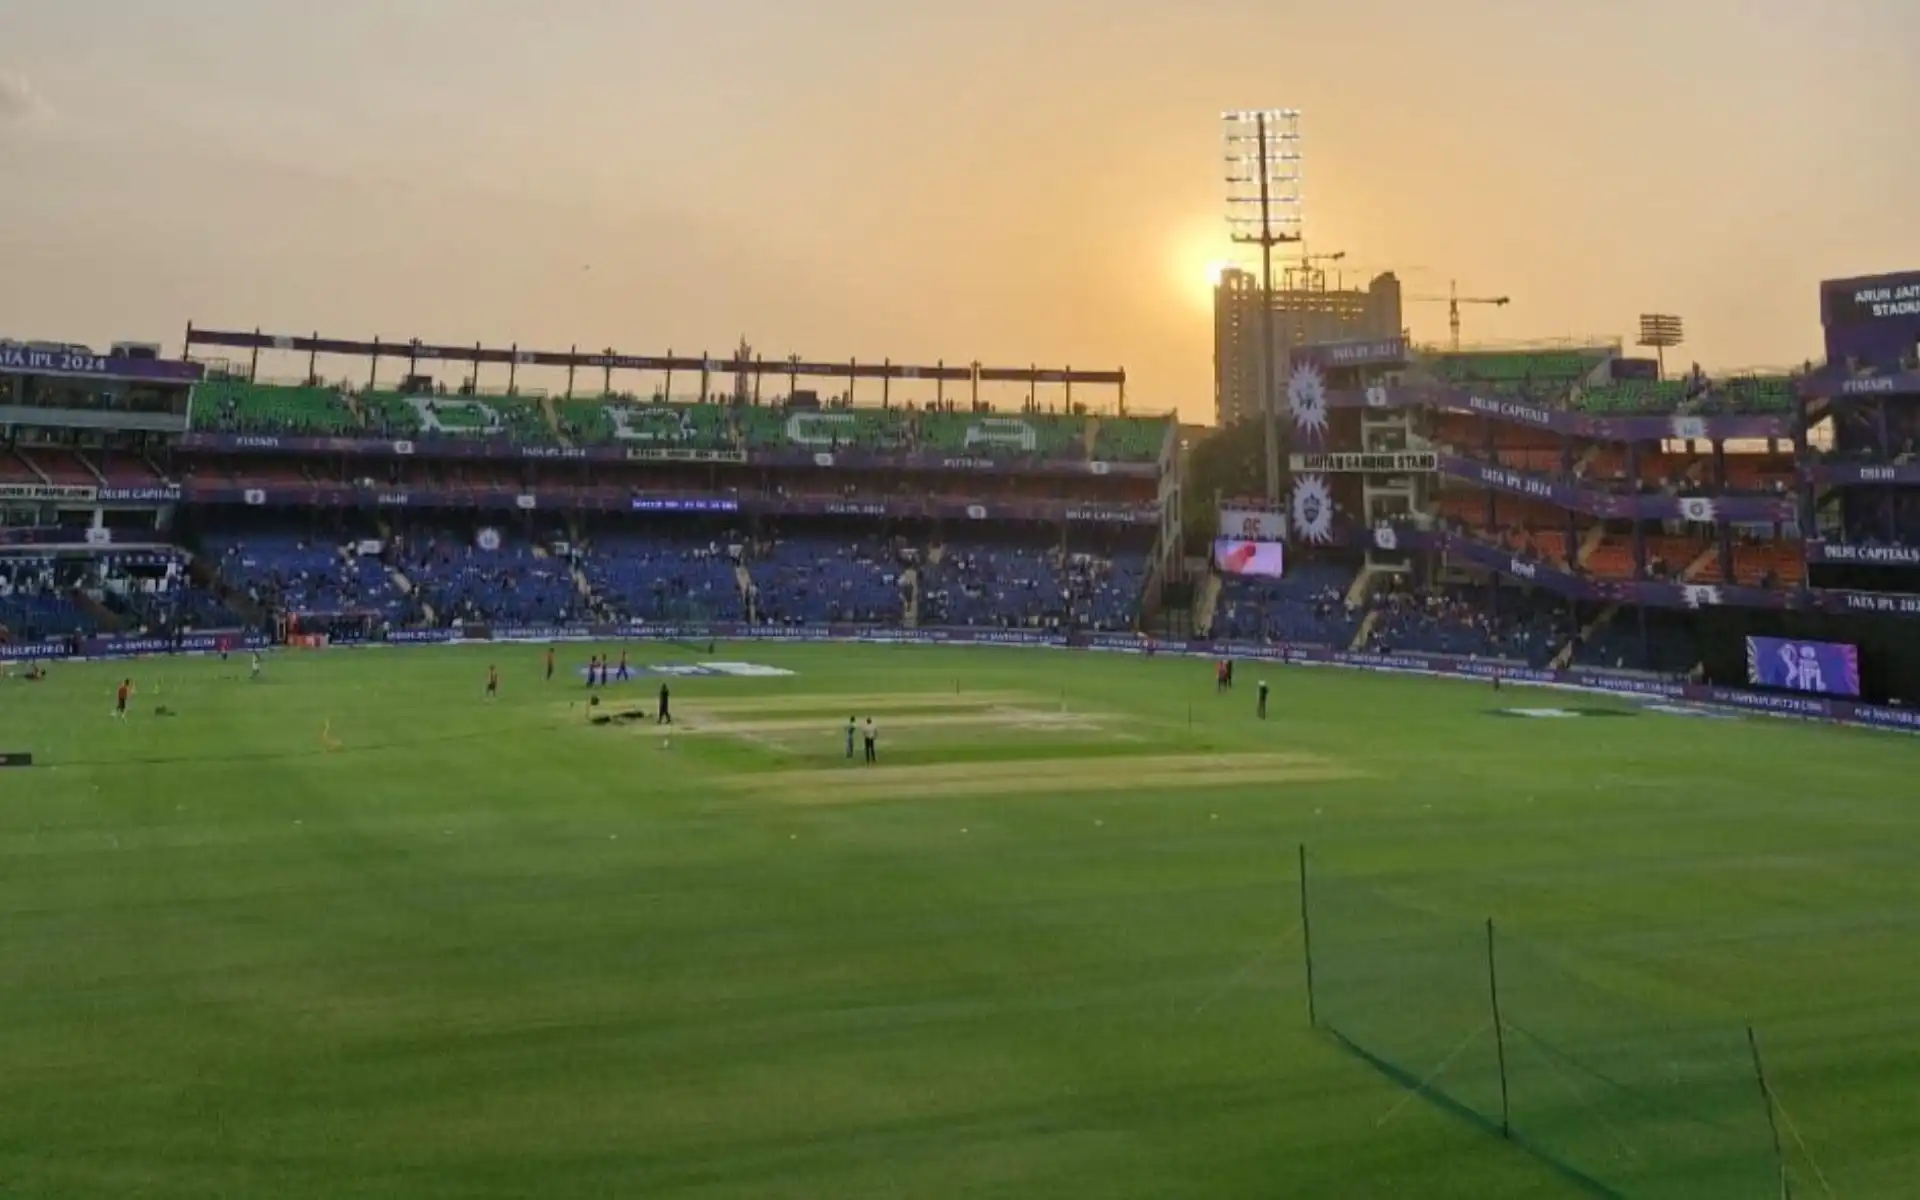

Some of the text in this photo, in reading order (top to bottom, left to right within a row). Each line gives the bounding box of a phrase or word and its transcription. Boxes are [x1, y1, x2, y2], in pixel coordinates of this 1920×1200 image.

[1855, 287, 1891, 303] ARUN
[30, 352, 54, 367] IPL
[61, 355, 106, 371] 2024
[1858, 547, 1920, 562] CAPITALS
[1847, 595, 1875, 609] TATA
[1877, 599, 1896, 610] IPL
